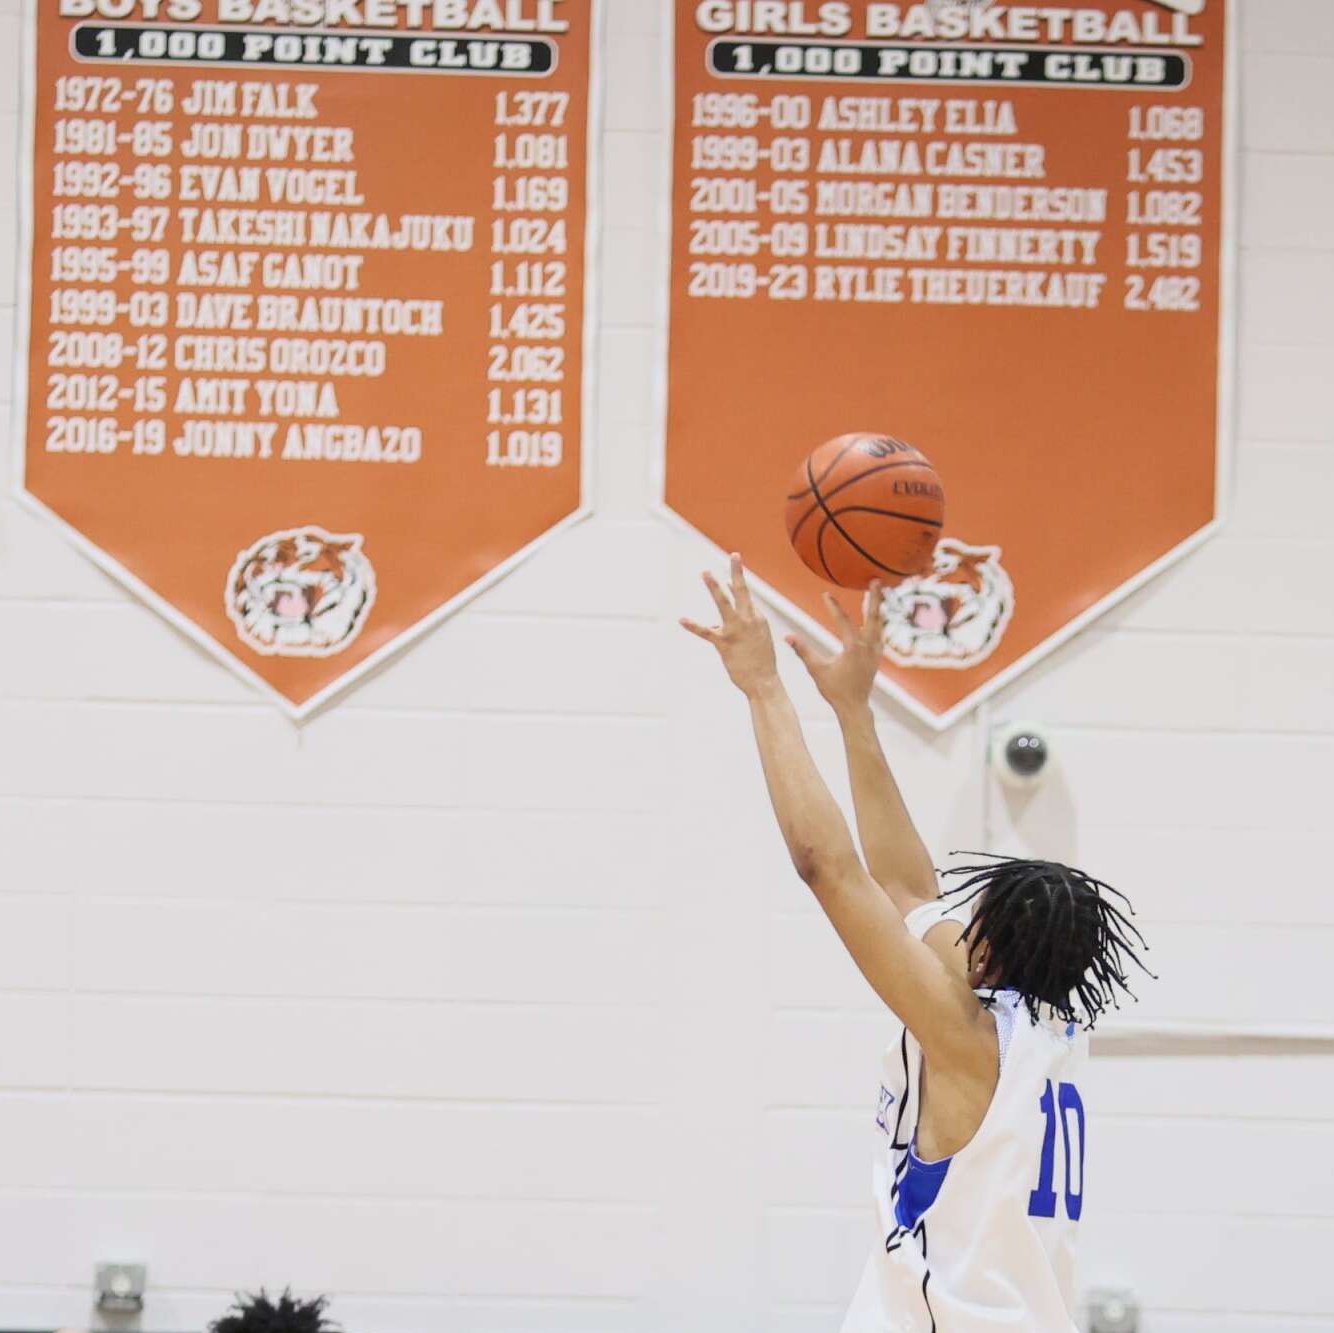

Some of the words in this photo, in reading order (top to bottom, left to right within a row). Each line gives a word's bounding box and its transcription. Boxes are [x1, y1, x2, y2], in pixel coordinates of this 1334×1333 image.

[219, 0, 569, 32] BASKETBALL
[696, 0, 852, 36] GIRLS
[866, 4, 1204, 46] BASKETBALL
[95, 29, 226, 61] 1,000
[242, 34, 393, 65] POINT
[409, 39, 532, 69] CLUB
[731, 45, 862, 75] 1,000
[877, 49, 1029, 79] POINT
[1043, 53, 1167, 83] CLUB
[55, 76, 173, 113] 1972-76
[182, 80, 237, 116] JIM
[241, 82, 319, 118] FALK
[818, 97, 940, 132] ASHLEY
[945, 100, 1016, 134] ELIA
[54, 119, 172, 156] 1981-85
[181, 123, 243, 158] JON
[247, 125, 353, 162] DWYER
[692, 135, 810, 171] 1999-03
[817, 139, 922, 174] ALANA
[53, 161, 171, 198] 1992-96
[179, 165, 262, 201] EVAN
[266, 168, 364, 205] VOGEL
[691, 177, 808, 214] 2001-05
[816, 181, 933, 217] MORGAN
[52, 204, 170, 241] 1993-97
[178, 207, 307, 246] TAKESHI
[690, 220, 808, 256] 2005-09
[947, 227, 1100, 264] FINNERTY
[51, 247, 170, 284] 1995-99
[177, 250, 260, 287] ASAF
[689, 262, 807, 299] 2019-23
[815, 266, 906, 302] RYLIE
[50, 289, 169, 326] 1999-03
[176, 292, 253, 329] DAVE
[48, 331, 167, 369] 2008-12
[175, 335, 267, 372] CHRIS
[270, 338, 385, 376] OROZCO
[47, 373, 167, 412] 2012-15
[46, 416, 166, 455] 2016-19
[173, 420, 278, 459] JONNY
[1027, 1077, 1085, 1222] 10
